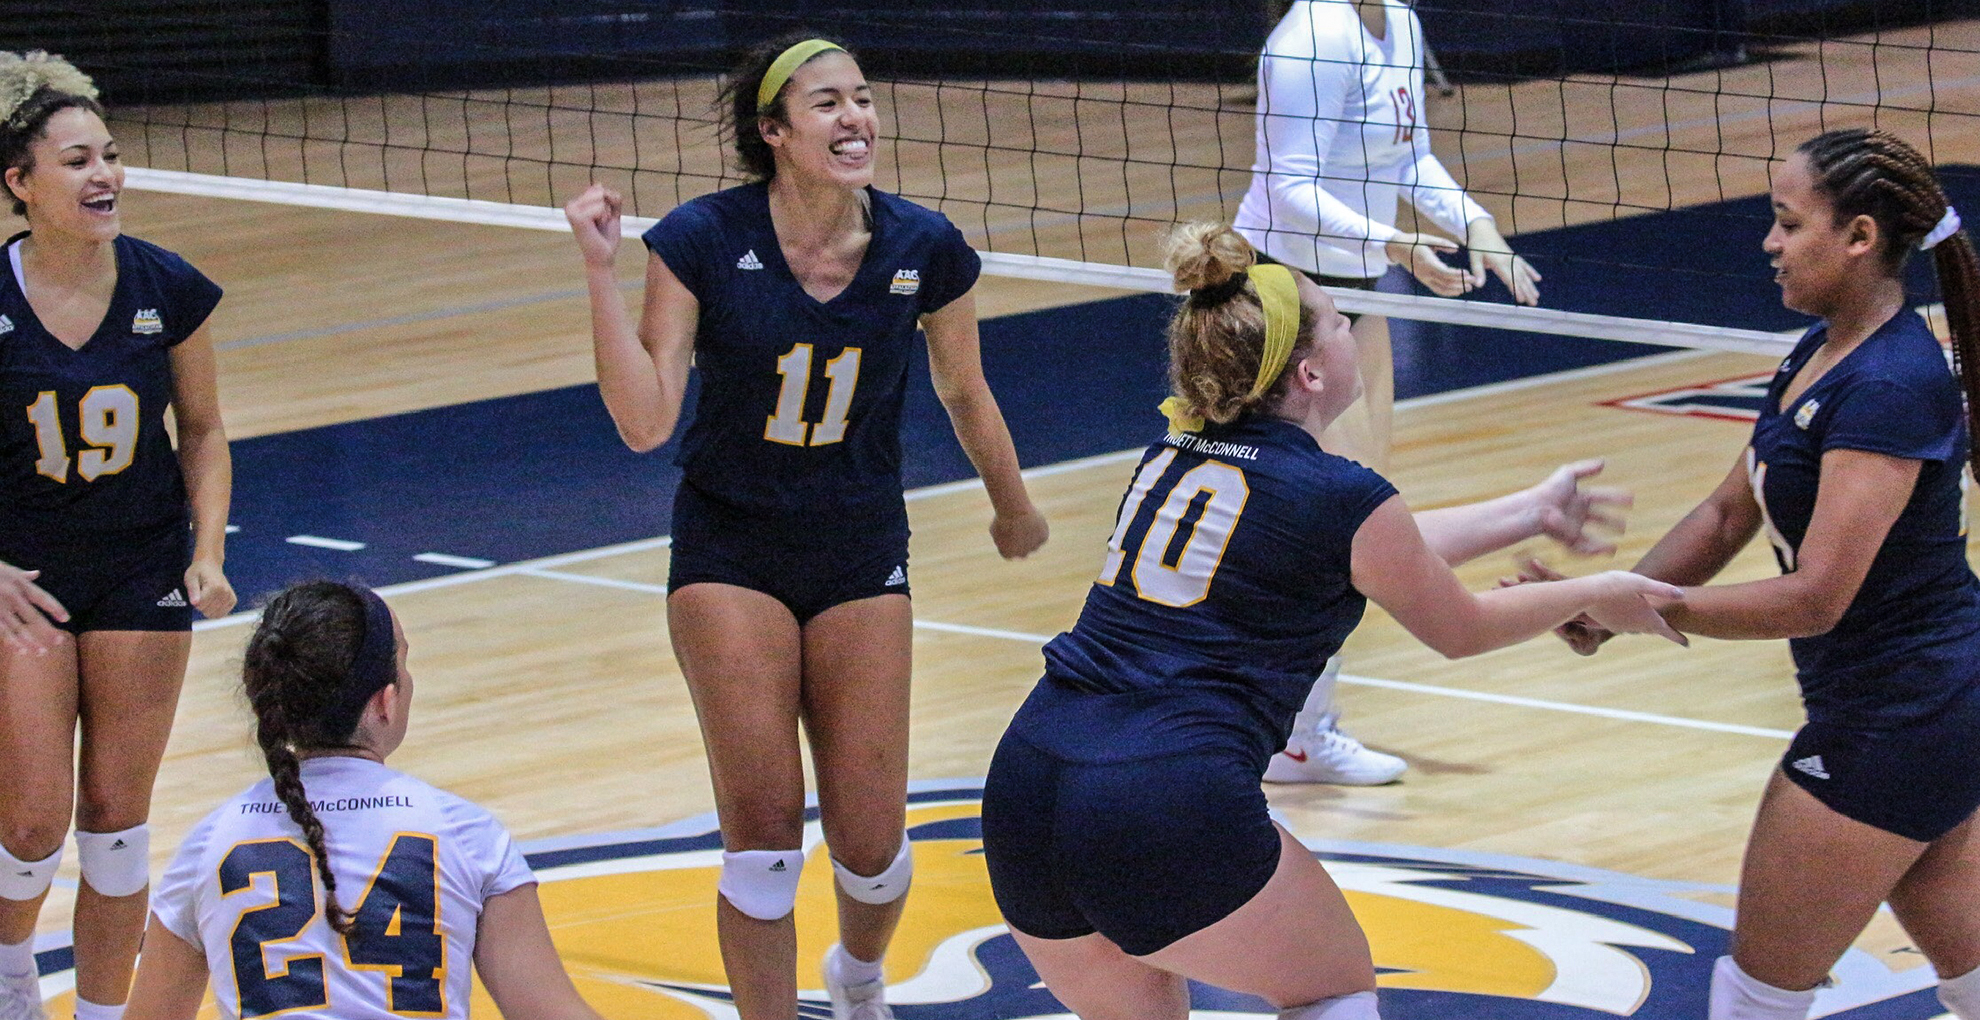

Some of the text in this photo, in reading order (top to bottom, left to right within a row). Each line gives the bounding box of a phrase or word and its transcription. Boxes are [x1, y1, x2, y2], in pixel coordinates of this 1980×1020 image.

[26, 383, 140, 485] 19
[763, 342, 862, 447] 11
[1192, 438, 1259, 461] McCONNELL
[1093, 447, 1251, 608] 10
[240, 795, 414, 815] TRUE McCONNELL
[217, 831, 448, 1020] 24
